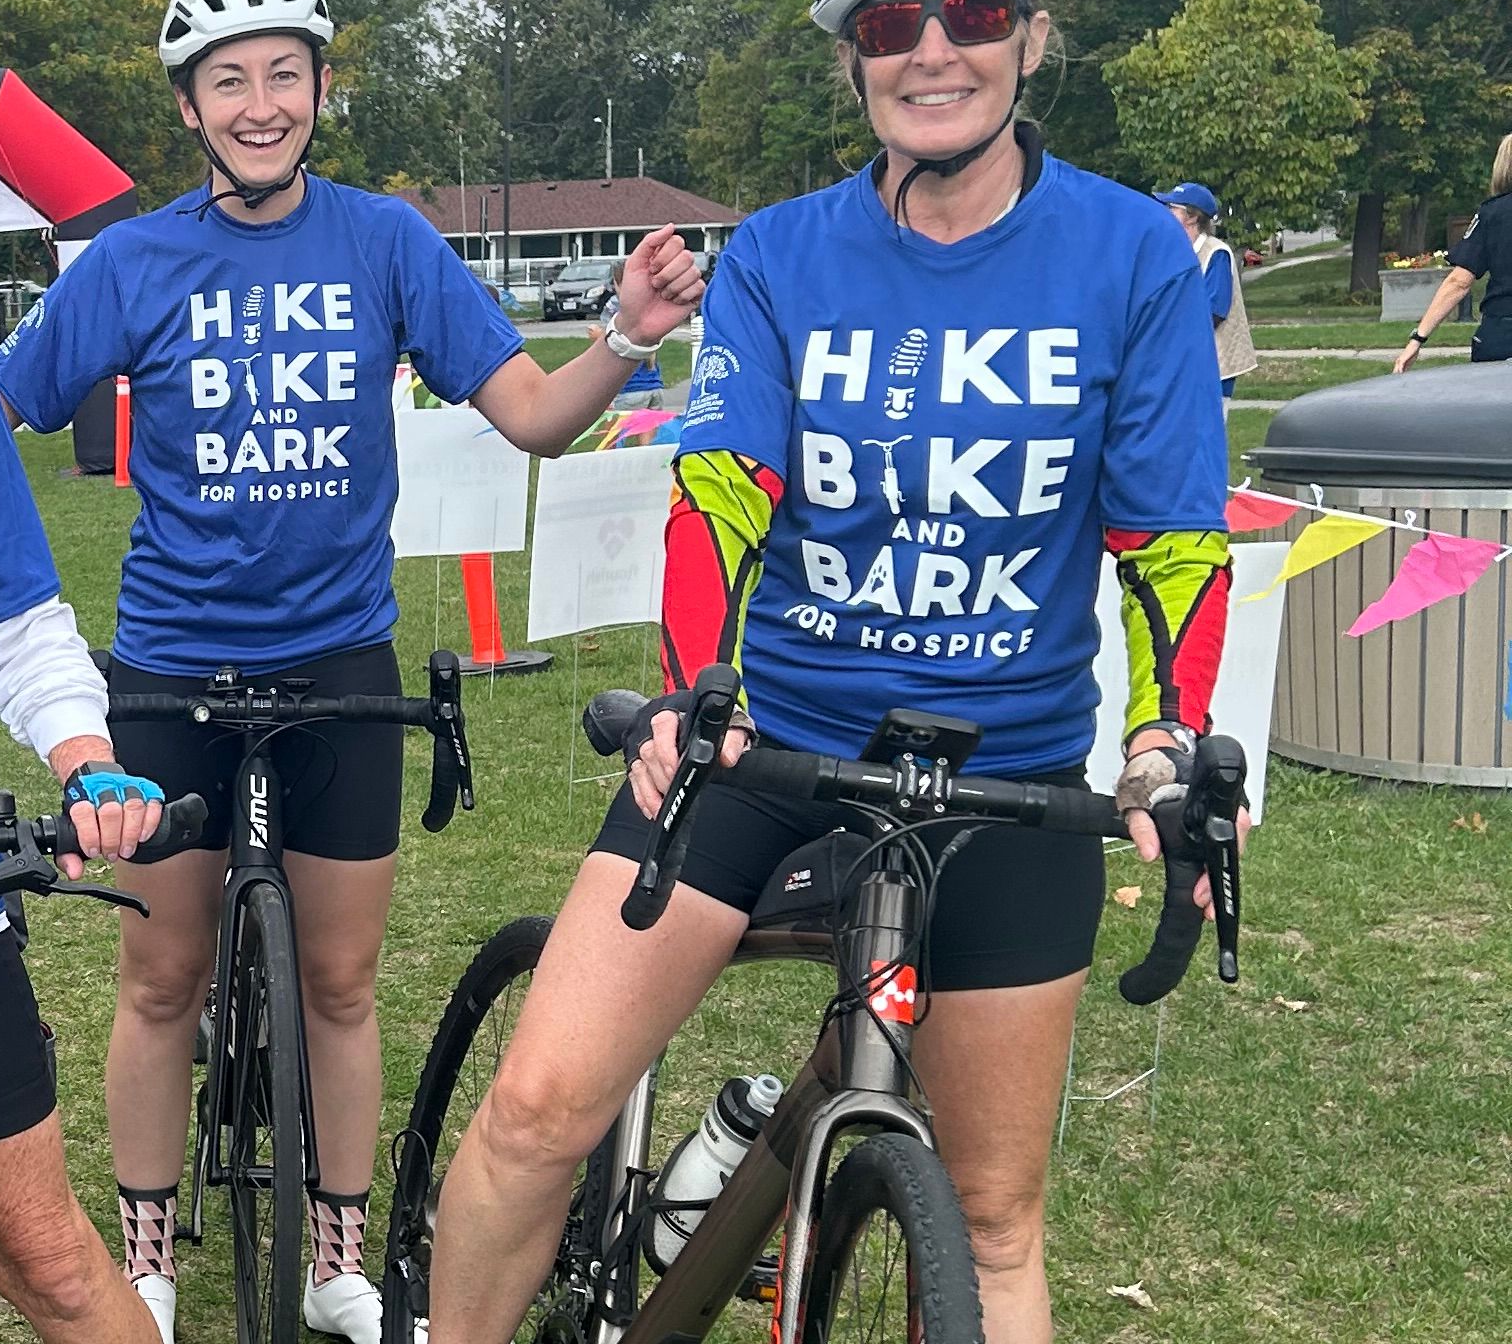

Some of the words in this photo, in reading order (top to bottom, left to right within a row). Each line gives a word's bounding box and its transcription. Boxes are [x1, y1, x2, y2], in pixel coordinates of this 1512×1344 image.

[251, 409, 297, 425] AND
[196, 424, 350, 474] BARK
[201, 485, 235, 501] FOR
[250, 479, 349, 501] HOSPICE
[892, 519, 966, 546] AND
[801, 541, 1041, 617] BARK
[784, 604, 836, 641] FOR
[861, 626, 1033, 657] HOSPICE
[249, 774, 268, 849] BMC
